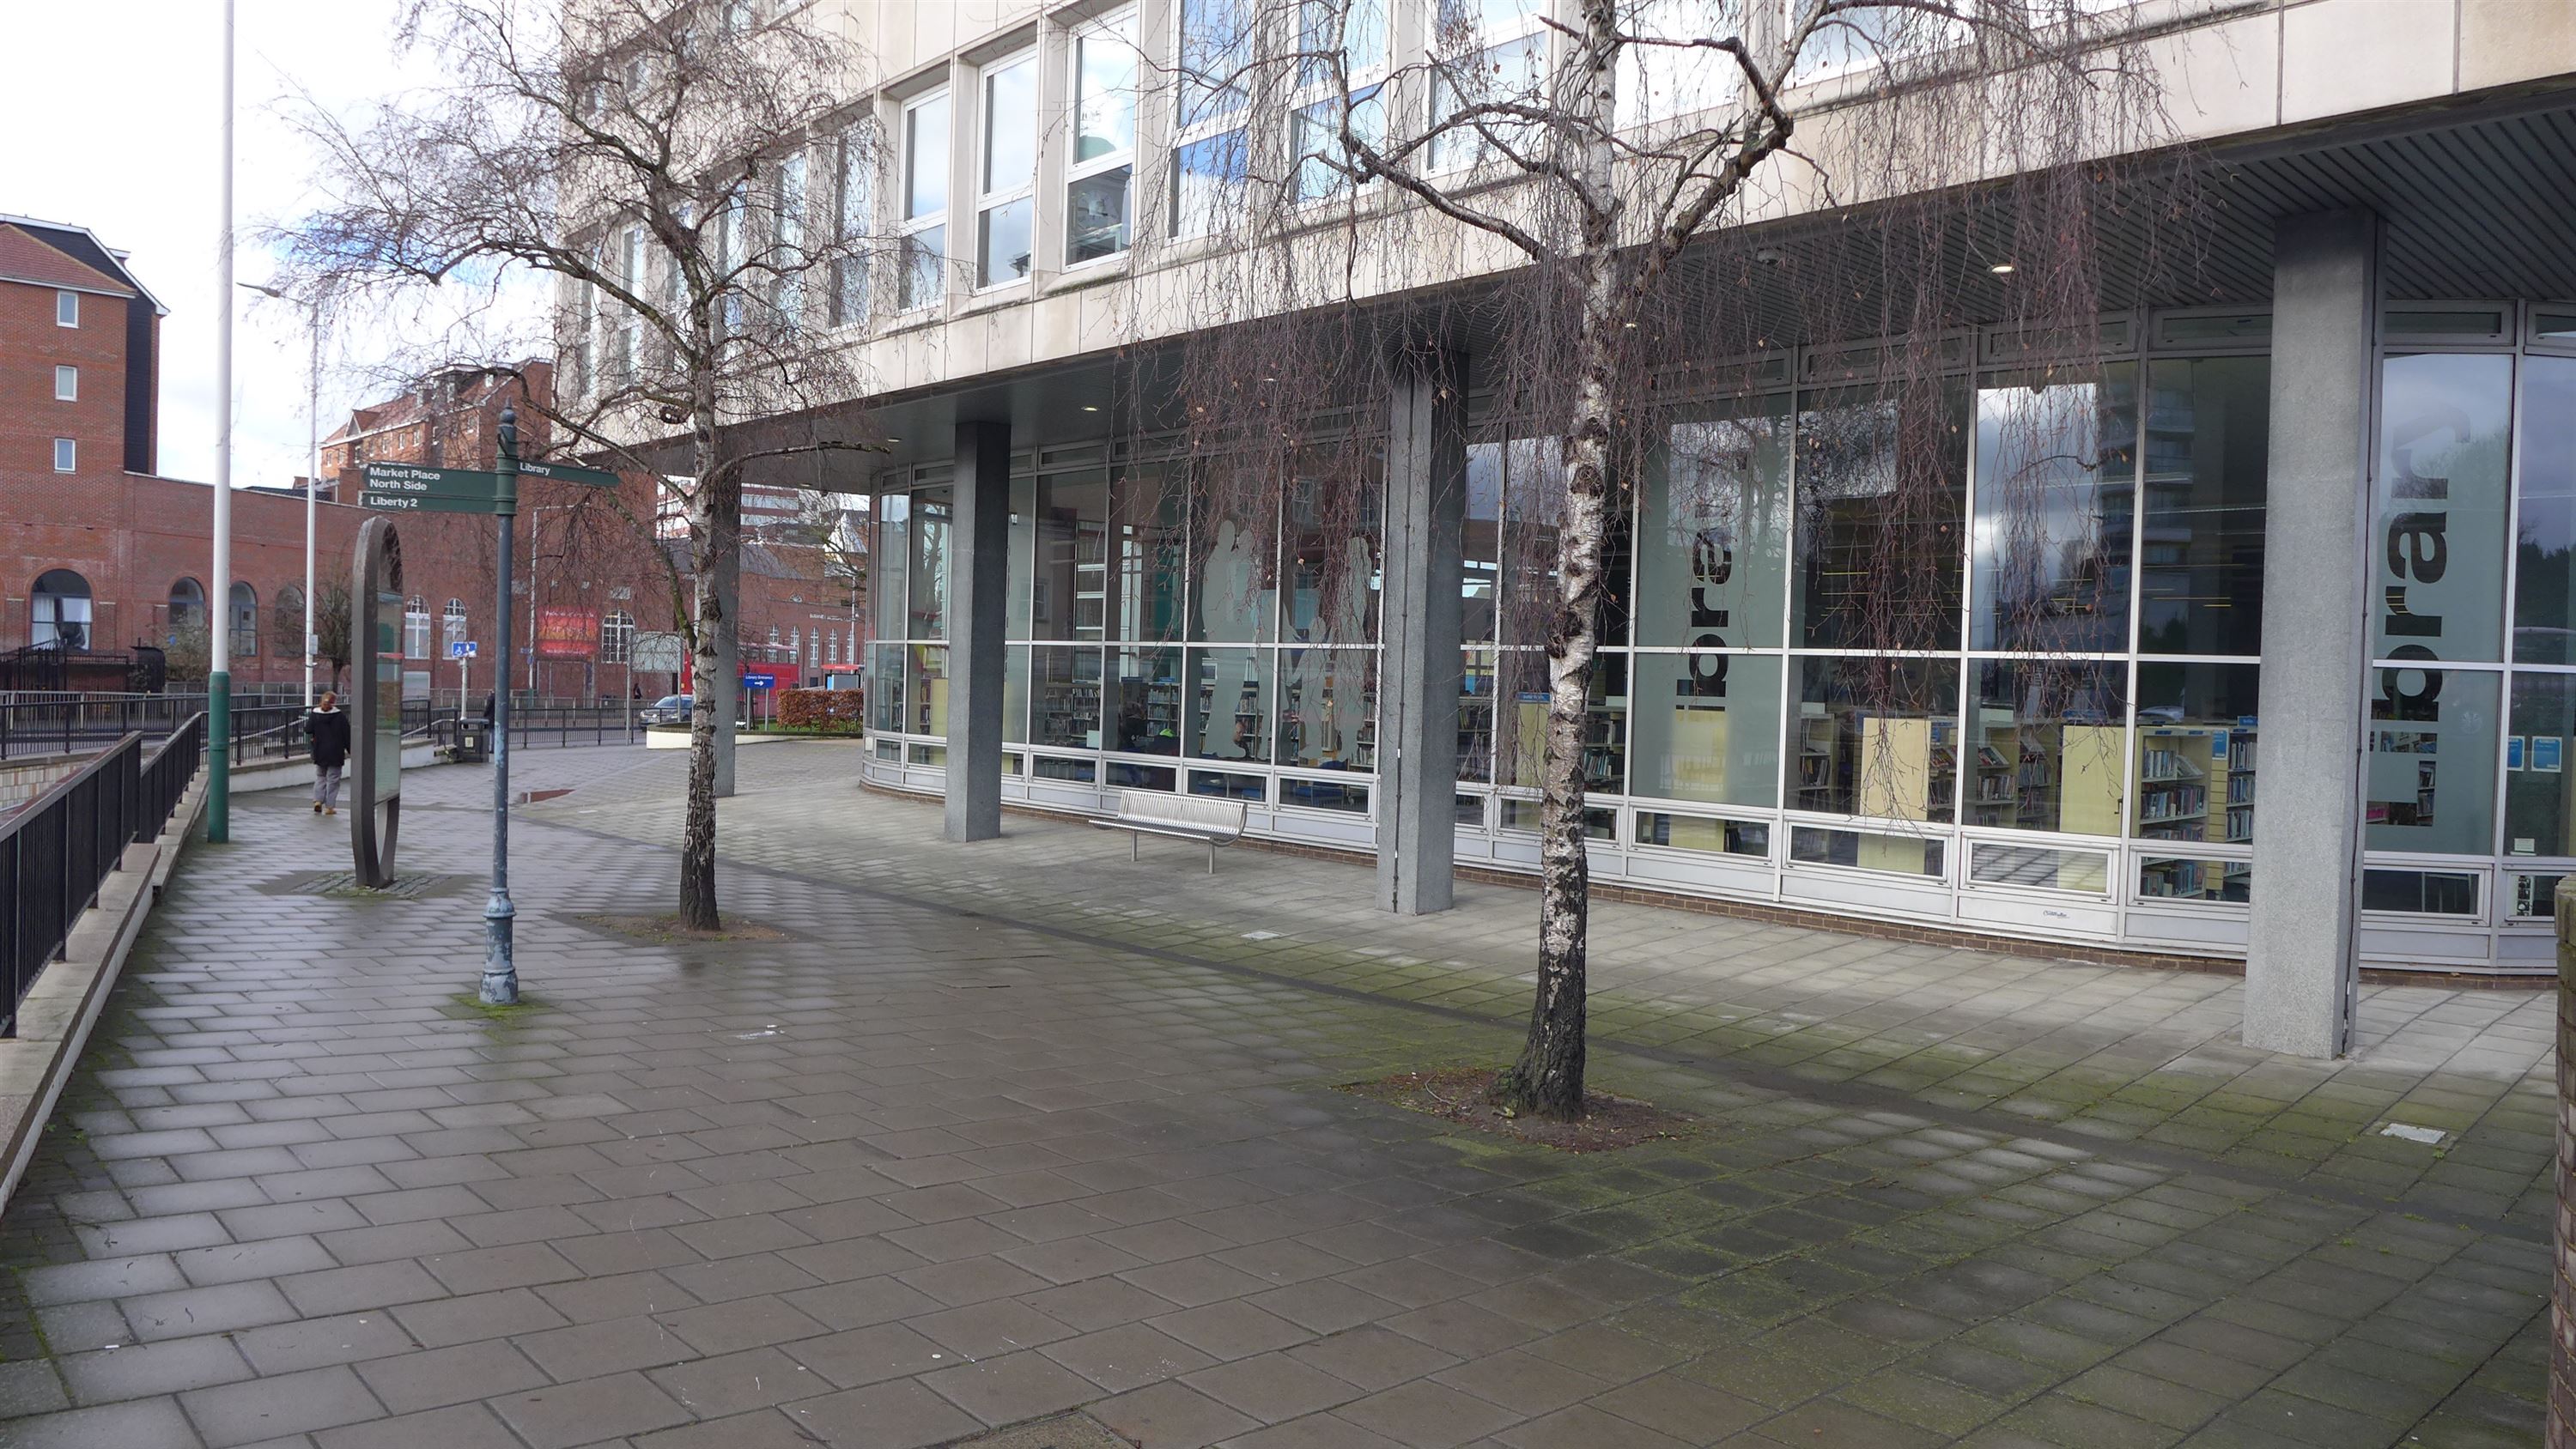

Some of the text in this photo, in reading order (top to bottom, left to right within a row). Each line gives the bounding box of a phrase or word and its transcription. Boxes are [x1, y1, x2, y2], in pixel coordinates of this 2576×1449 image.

[370, 467, 440, 480] Market Place
[519, 462, 550, 476] Library
[370, 479, 428, 491] North Side
[370, 496, 418, 508] Liberty 2
[2366, 405, 2471, 827] Library
